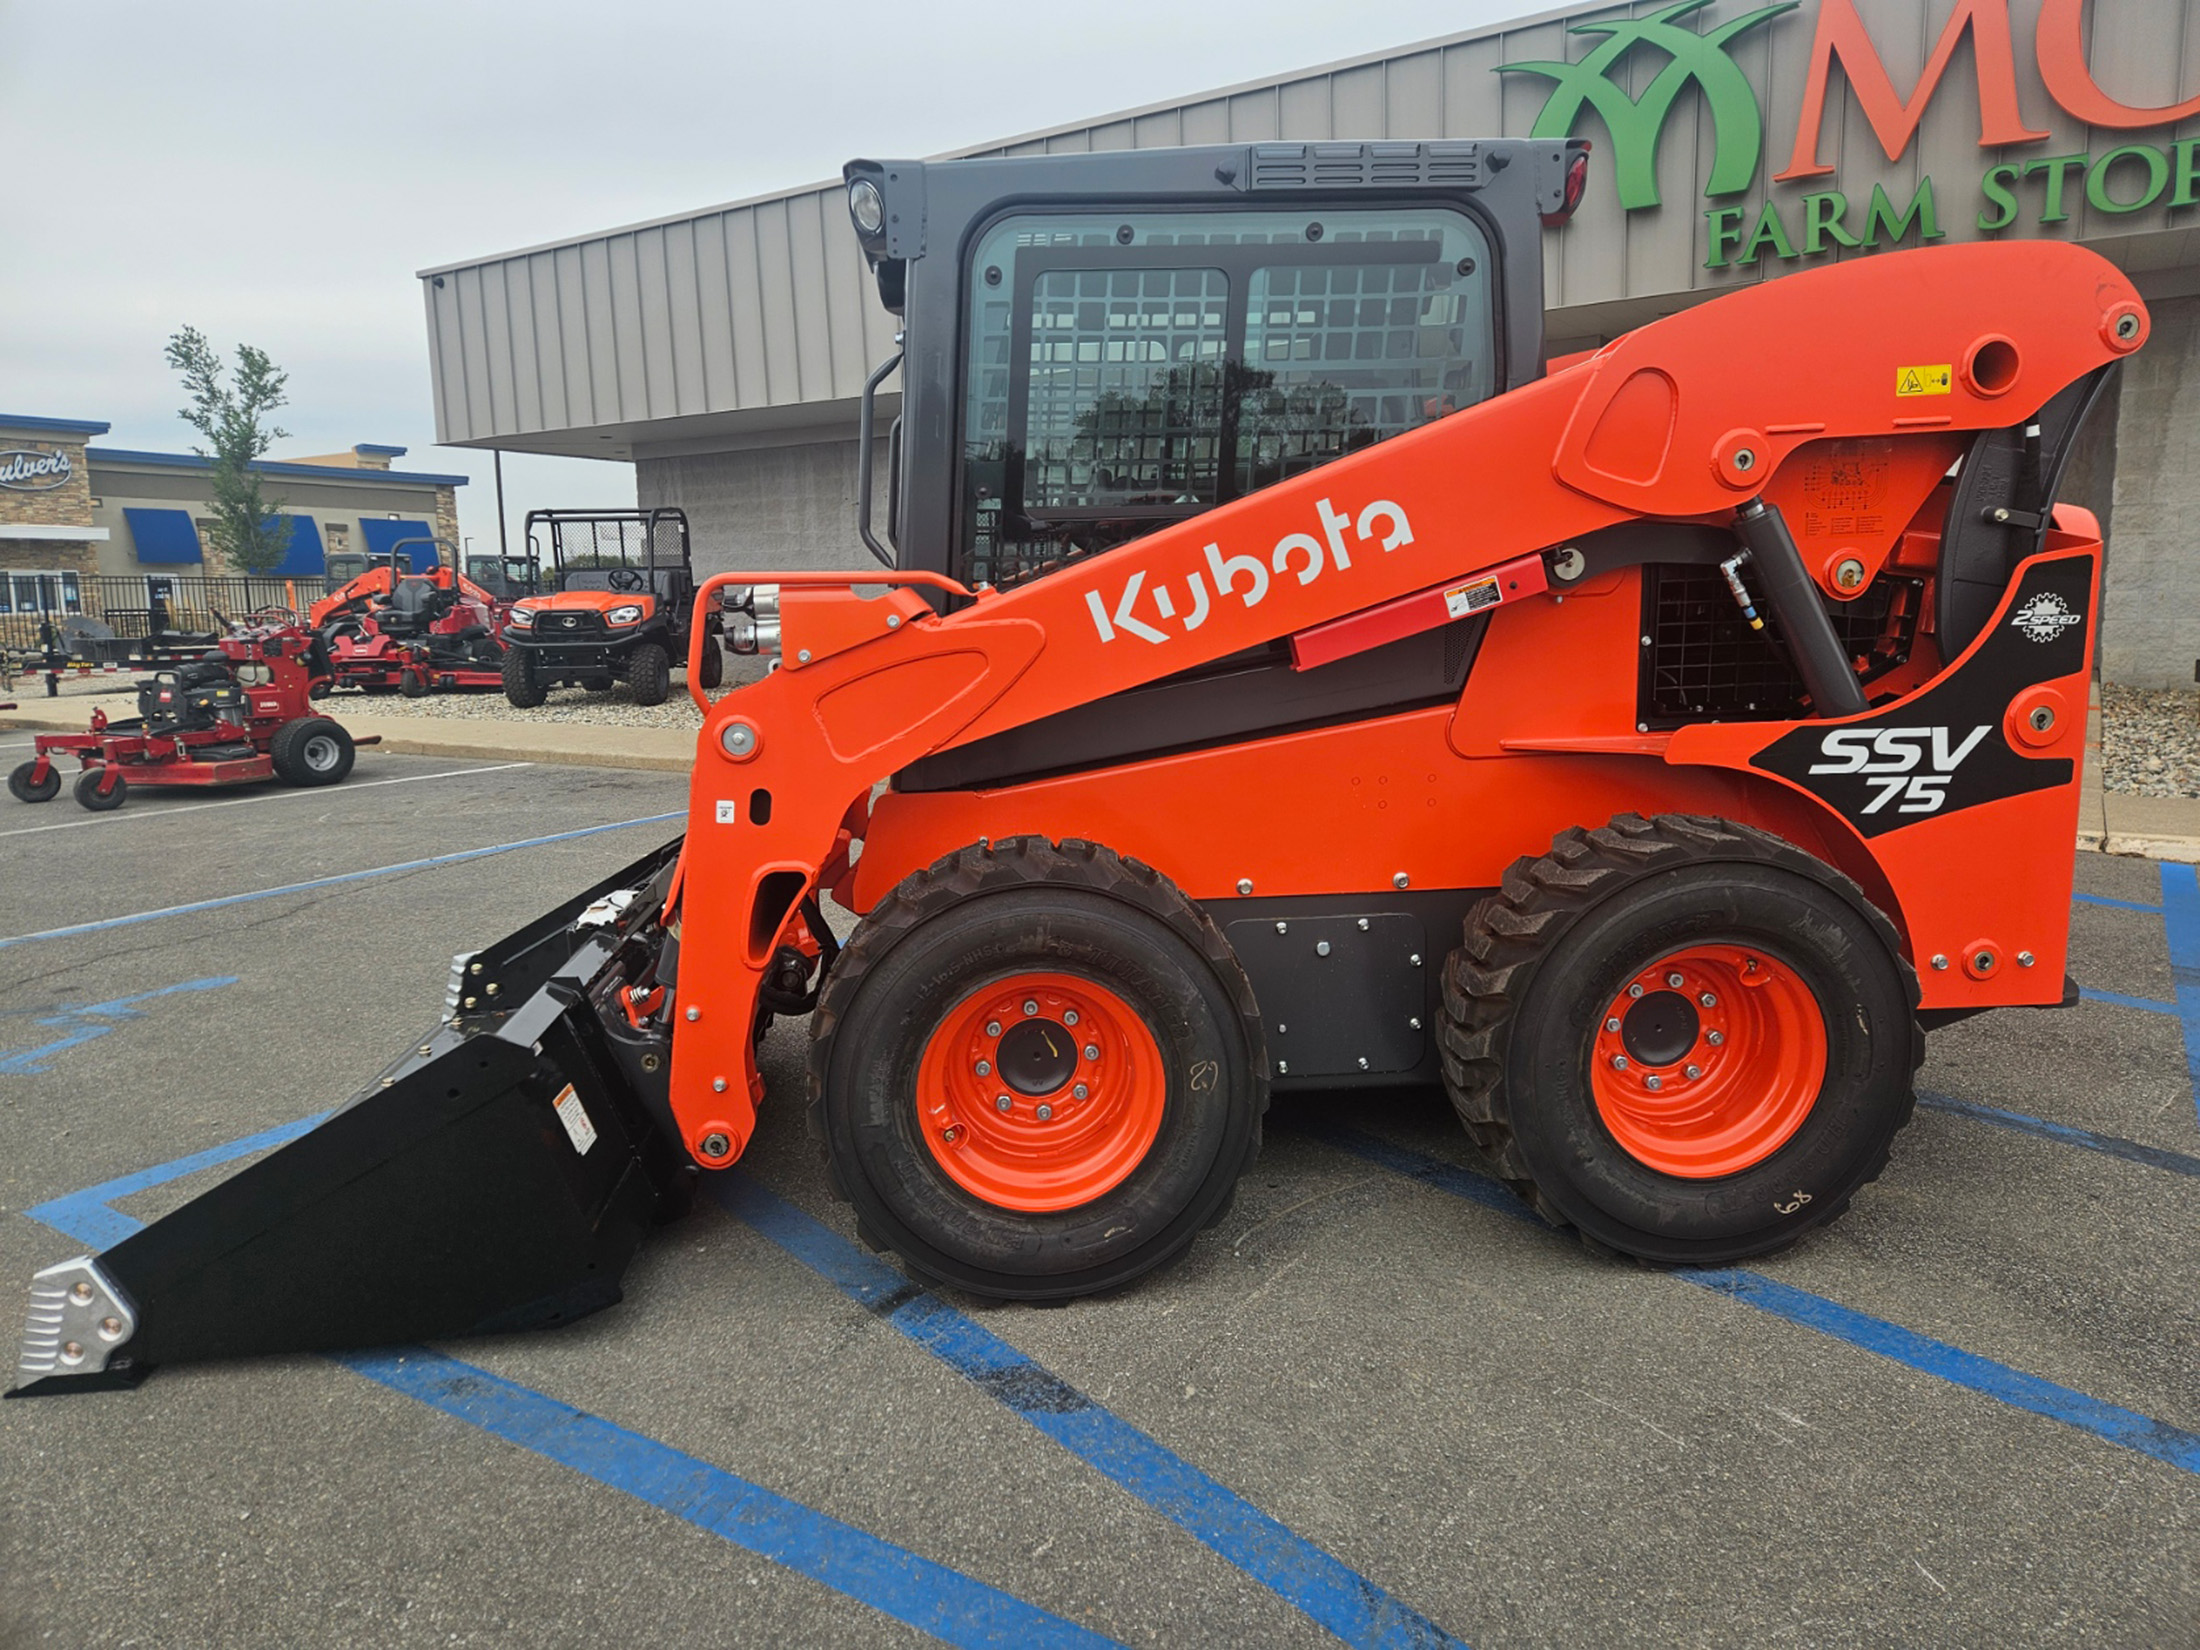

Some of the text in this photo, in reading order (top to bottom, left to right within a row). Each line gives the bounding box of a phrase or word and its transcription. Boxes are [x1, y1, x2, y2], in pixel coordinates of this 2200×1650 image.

[1703, 175, 1946, 269] FARM
[1084, 497, 1415, 645] Kubota
[1808, 725, 1994, 775] SSV
[1860, 775, 1953, 814] 75
